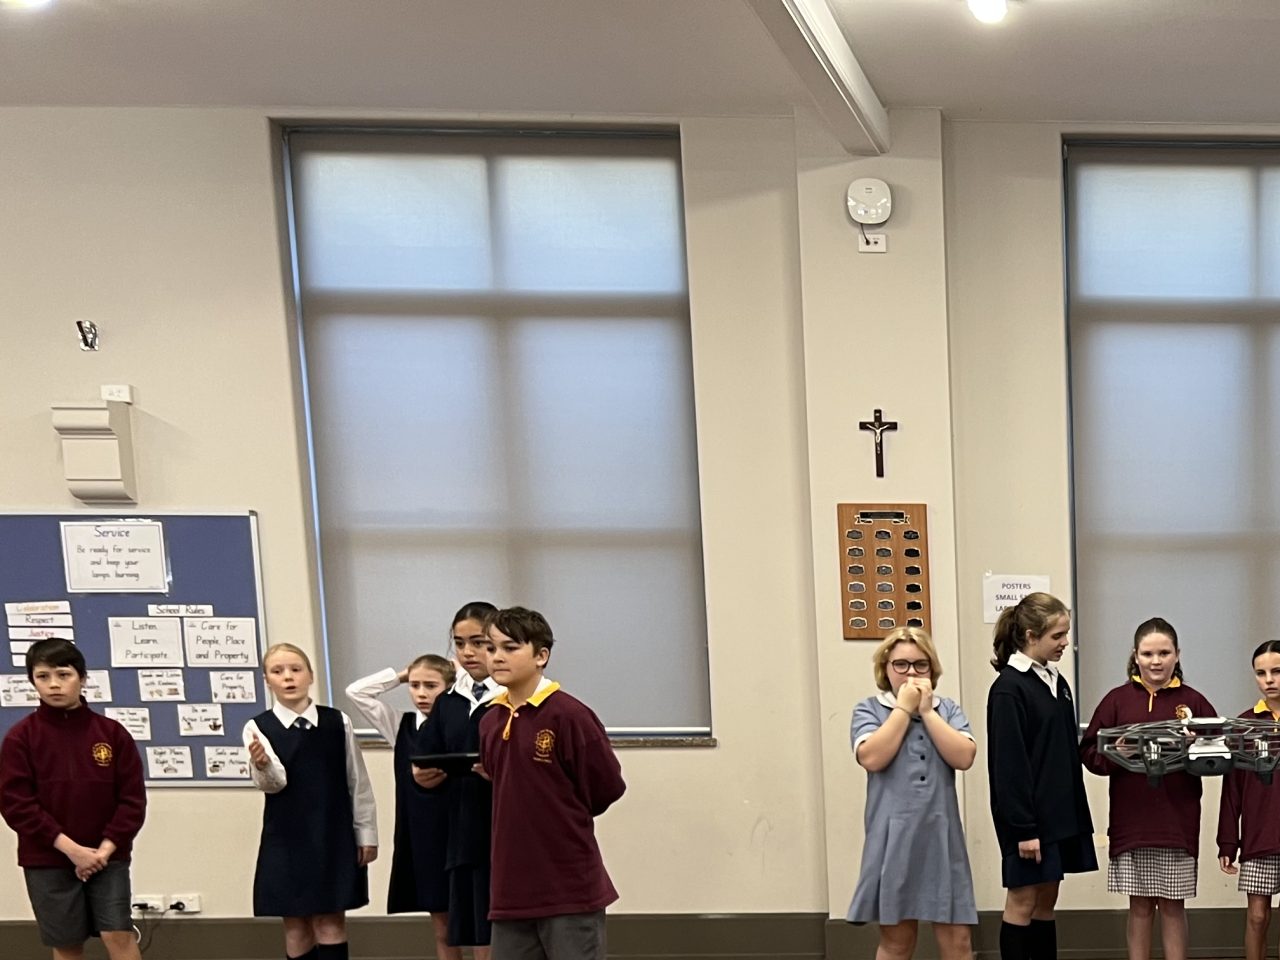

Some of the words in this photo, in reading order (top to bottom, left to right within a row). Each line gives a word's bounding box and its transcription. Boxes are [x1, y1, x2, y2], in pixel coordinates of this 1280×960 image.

[94, 525, 130, 537] Service
[77, 545, 86, 553] Be
[90, 545, 108, 556] ready
[112, 544, 123, 553] for
[106, 558, 120, 567] keep
[125, 560, 139, 568] your
[115, 571, 139, 581] burning
[156, 604, 180, 614] School
[185, 604, 206, 614] Rules
[25, 613, 54, 624] Respect
[201, 621, 221, 630] Care
[226, 620, 238, 630] for
[29, 629, 54, 637] Justice
[226, 635, 245, 645] Place
[125, 649, 168, 661] Participate
[195, 651, 209, 659] and
[215, 651, 249, 662] Property
